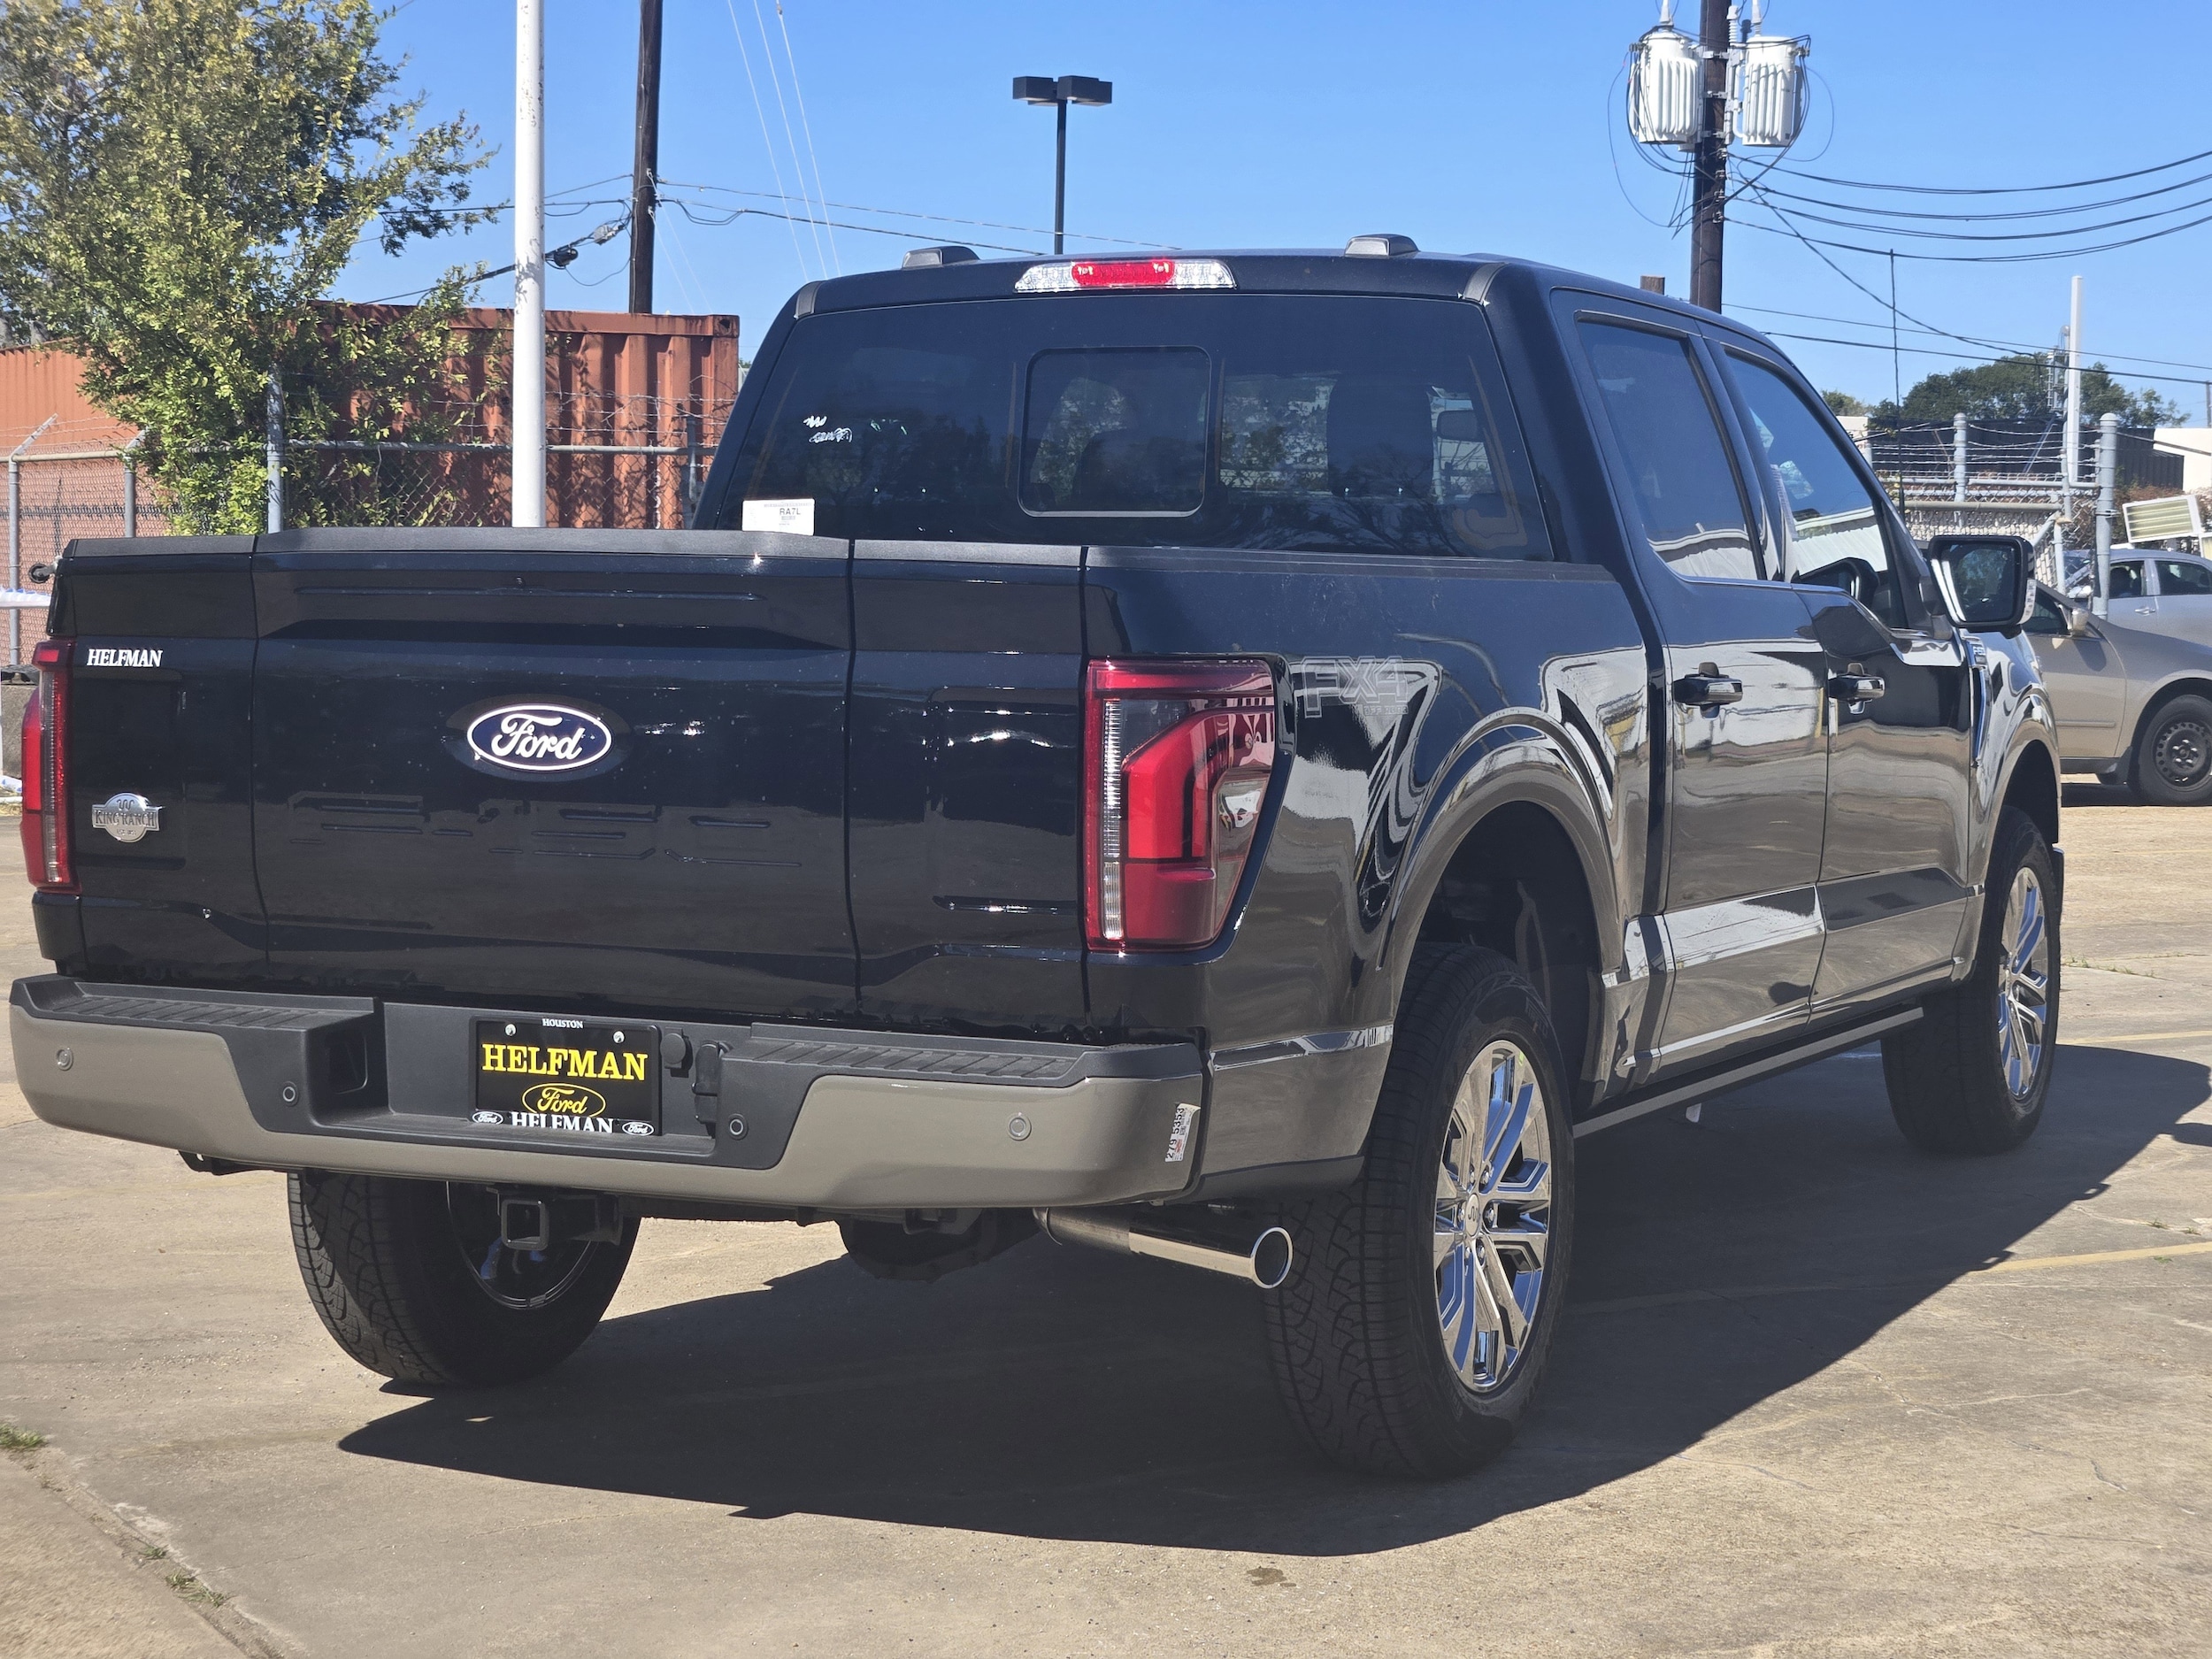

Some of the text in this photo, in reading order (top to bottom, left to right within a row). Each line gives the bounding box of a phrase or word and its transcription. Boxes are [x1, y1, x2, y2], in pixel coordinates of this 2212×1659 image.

[87, 649, 163, 667] HELFMAN
[1301, 655, 1409, 718] FX4
[491, 713, 586, 759] Ford
[94, 810, 155, 826] KING RANCH
[542, 1018, 583, 1028] HOUSTON
[482, 1043, 648, 1080] HELFMAN
[537, 1087, 588, 1115] Ford
[511, 1111, 613, 1133] HELFMAN
